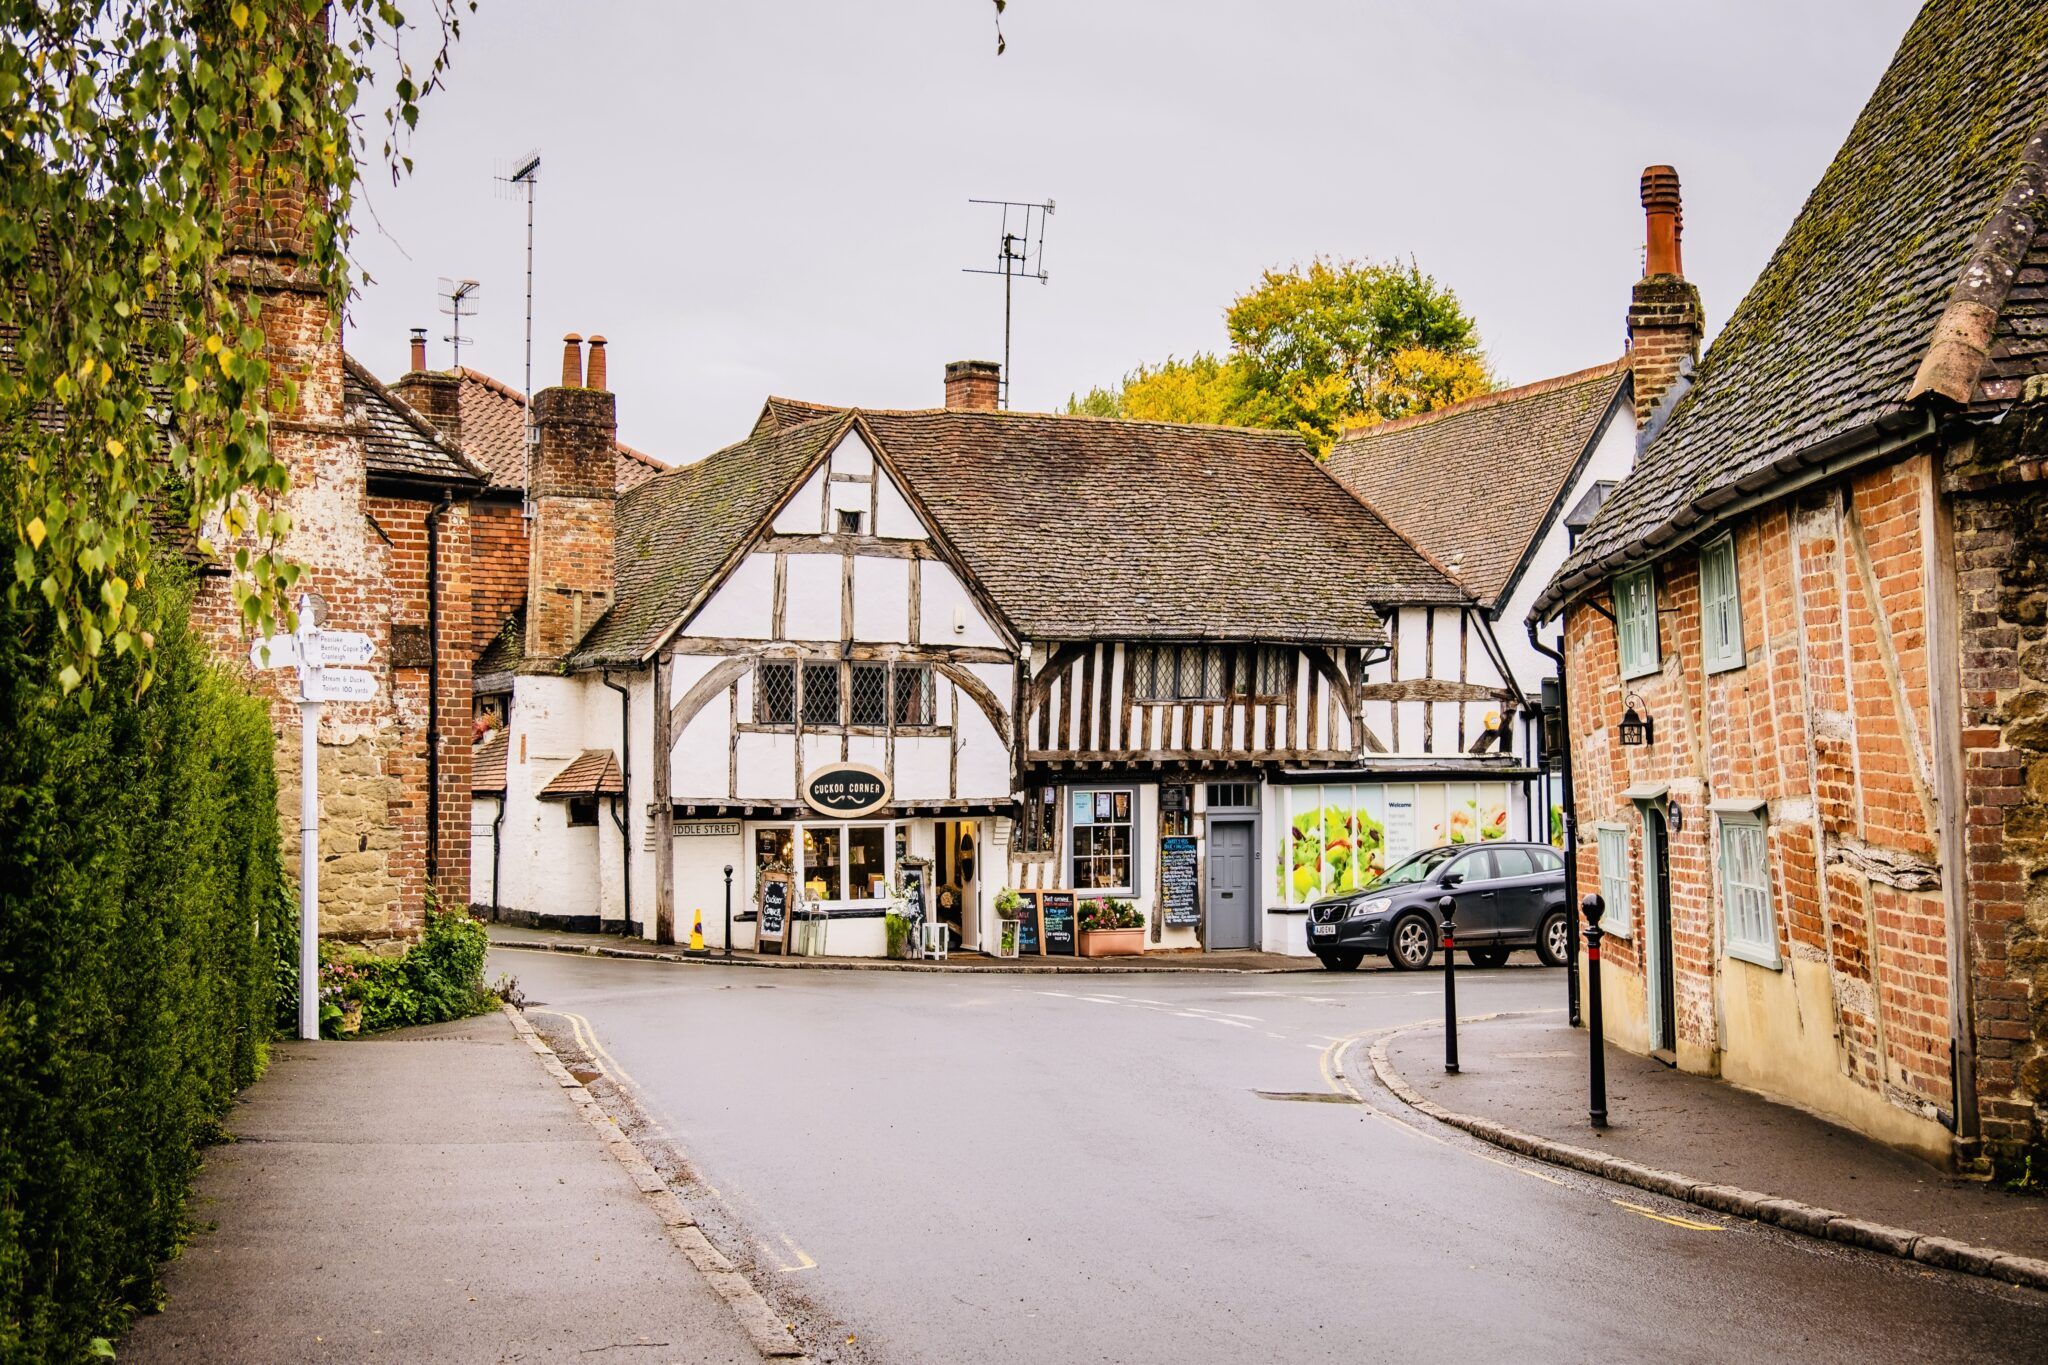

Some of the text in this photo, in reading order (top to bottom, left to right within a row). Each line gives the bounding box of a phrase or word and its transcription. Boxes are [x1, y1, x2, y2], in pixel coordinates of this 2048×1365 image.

[342, 685, 352, 693] 100
[354, 686, 368, 694] yards
[814, 782, 880, 795] CUCKOO CORNER
[674, 824, 737, 835] IDDLE STREET
